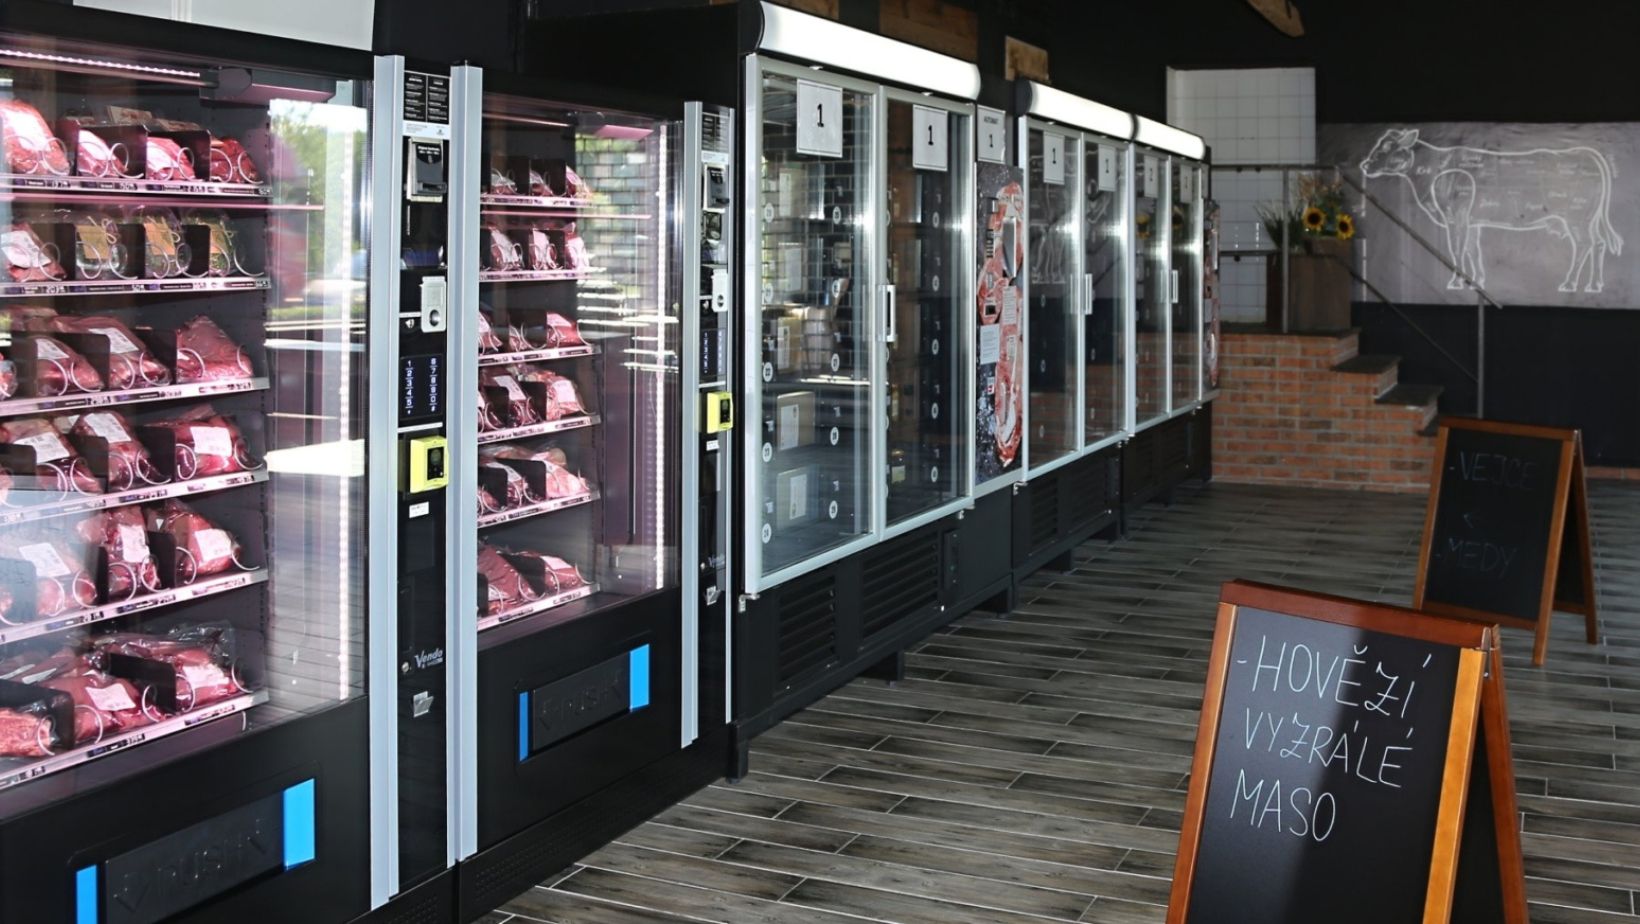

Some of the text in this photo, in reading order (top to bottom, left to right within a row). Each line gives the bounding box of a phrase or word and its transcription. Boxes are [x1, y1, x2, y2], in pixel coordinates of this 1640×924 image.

[817, 103, 824, 127] 1
[928, 125, 934, 146] 1
[989, 134, 994, 148] 1
[1052, 148, 1057, 164] 1
[406, 379, 412, 387] 3
[1246, 707, 1414, 788] VYZRÁLÉ
[1230, 768, 1336, 842] MASO
